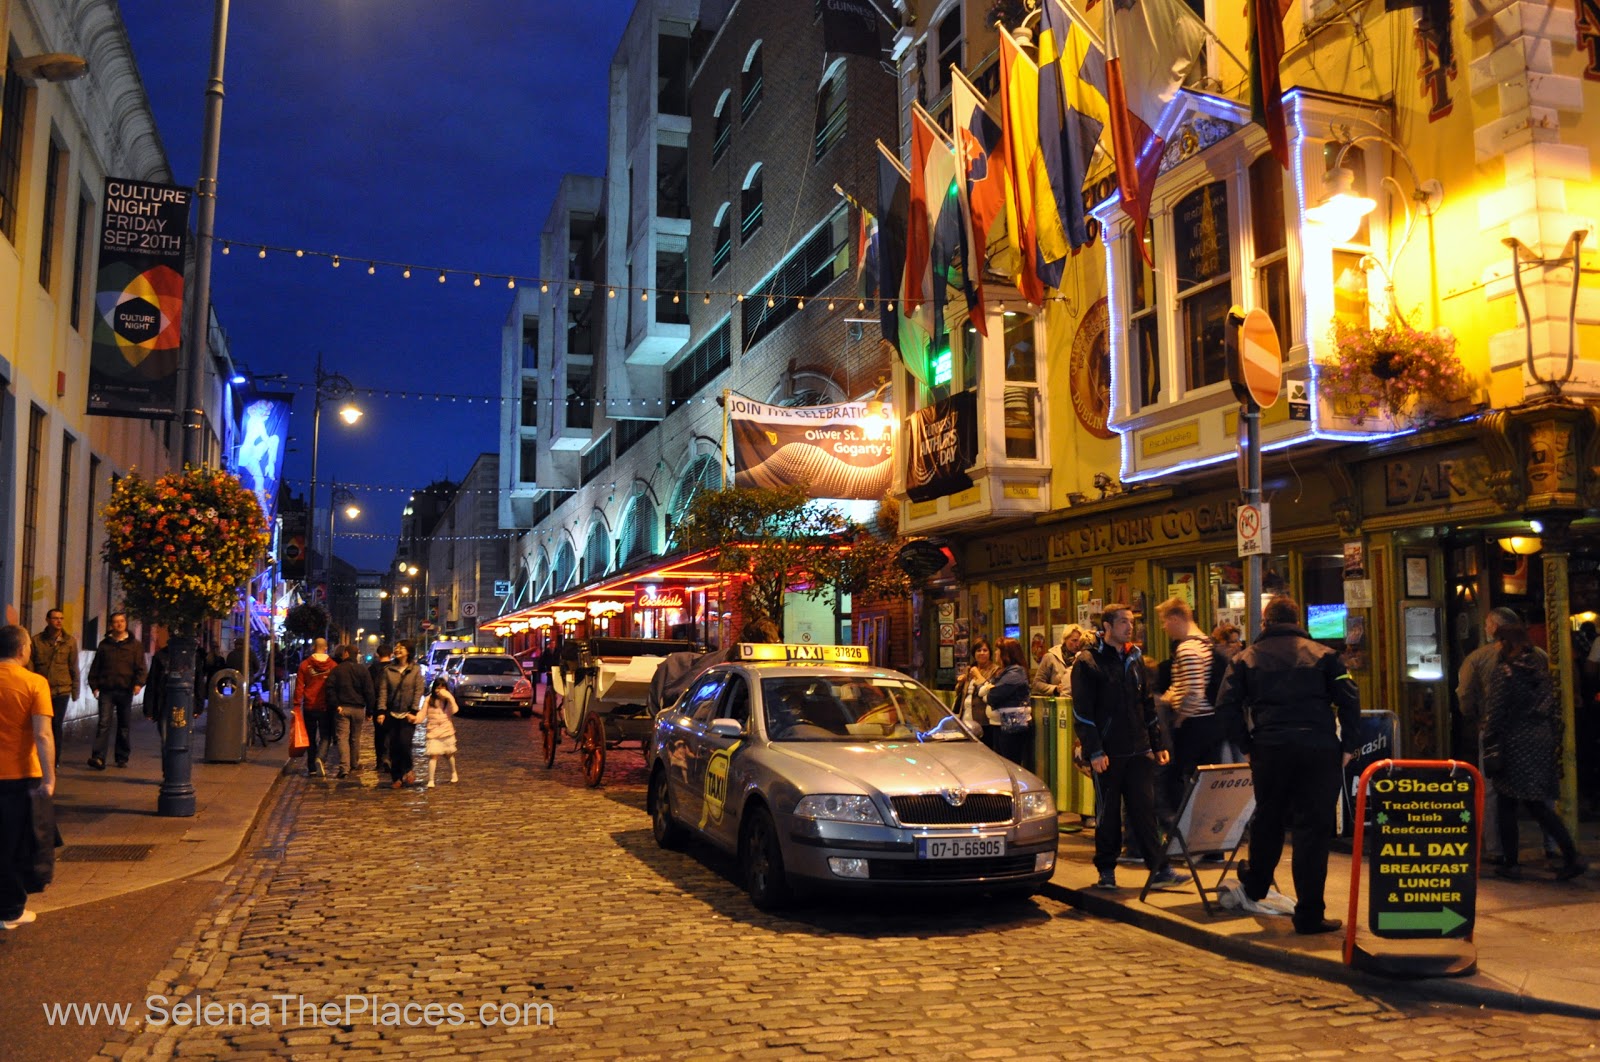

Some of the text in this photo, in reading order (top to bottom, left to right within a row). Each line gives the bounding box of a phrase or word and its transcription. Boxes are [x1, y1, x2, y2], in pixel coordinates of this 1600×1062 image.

[107, 182, 186, 204] CULTURE
[107, 198, 162, 217] NIGHT
[105, 213, 168, 233] FRIDAY
[103, 229, 181, 249] SEP 20TH
[119, 313, 155, 323] CULTURE
[124, 321, 151, 331] NIGHT
[731, 401, 761, 416] JOIN
[795, 404, 889, 419] CELEBRATIOS
[1073, 391, 1104, 430] DUBLIN
[805, 430, 842, 441] Oliver
[844, 429, 859, 441] St.
[833, 442, 892, 457] Gogarty's
[940, 446, 957, 466] DAY
[1385, 461, 1466, 506] BAR
[1161, 500, 1237, 540] GOGAR
[639, 594, 683, 607] Cocktails
[786, 645, 823, 659] TAXI
[834, 647, 862, 659] 37826
[1375, 778, 1469, 793] O'Shea's
[1382, 801, 1465, 810] Traditional
[1407, 813, 1443, 822] Irish
[1381, 825, 1468, 834] Restaurant
[931, 840, 1000, 857] 07-D-66905
[1380, 843, 1469, 857] ALL DAY
[1380, 863, 1469, 874] BREAKFAST
[1398, 878, 1451, 888] LUNCH
[1387, 892, 1461, 903] & DINNER
